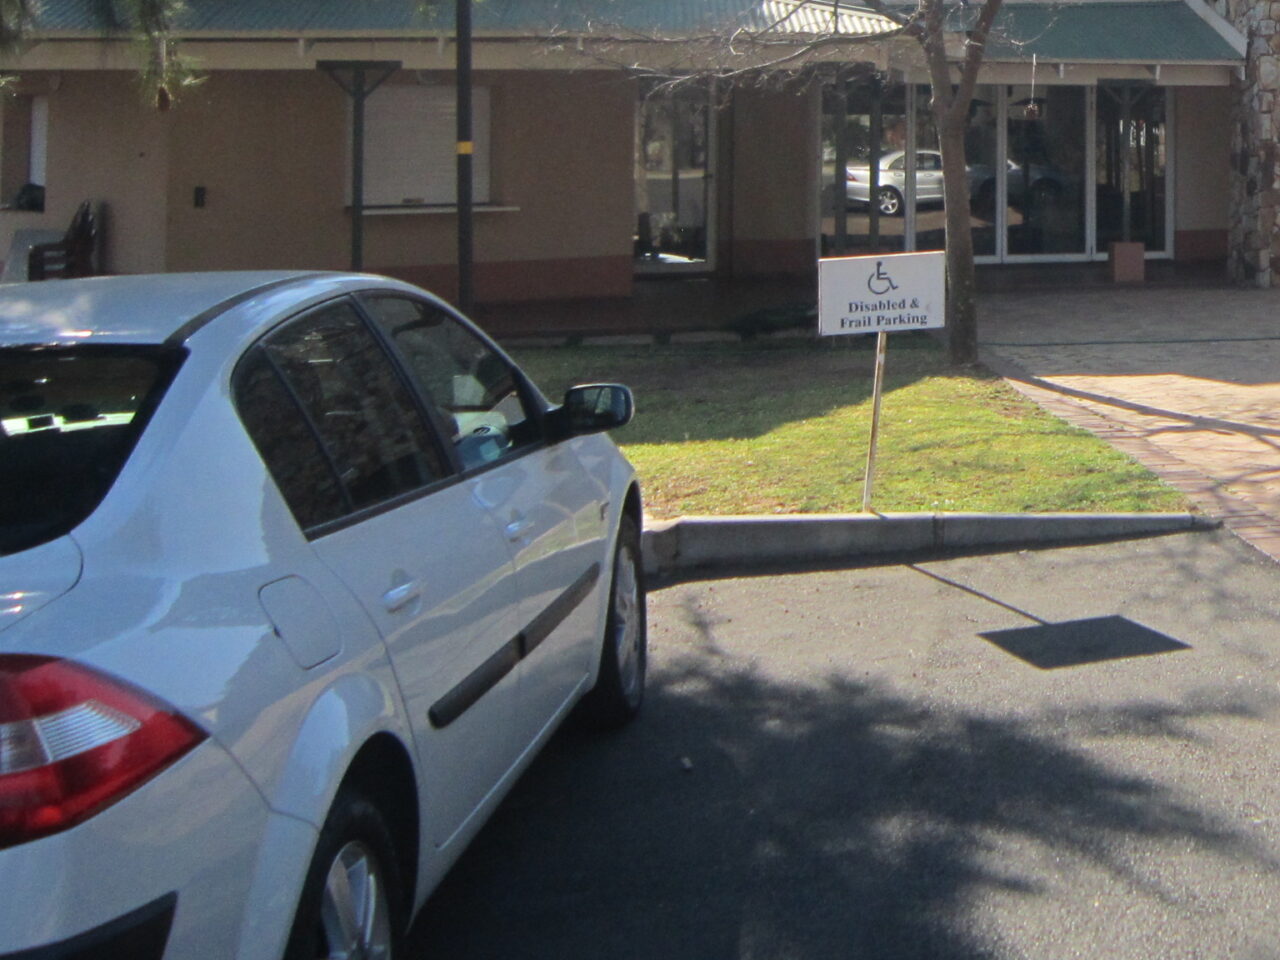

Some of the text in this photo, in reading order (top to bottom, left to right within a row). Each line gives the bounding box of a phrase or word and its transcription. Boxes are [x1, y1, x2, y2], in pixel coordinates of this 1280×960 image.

[848, 297, 919, 313] Disabled &
[840, 313, 927, 328] Frail Parking
